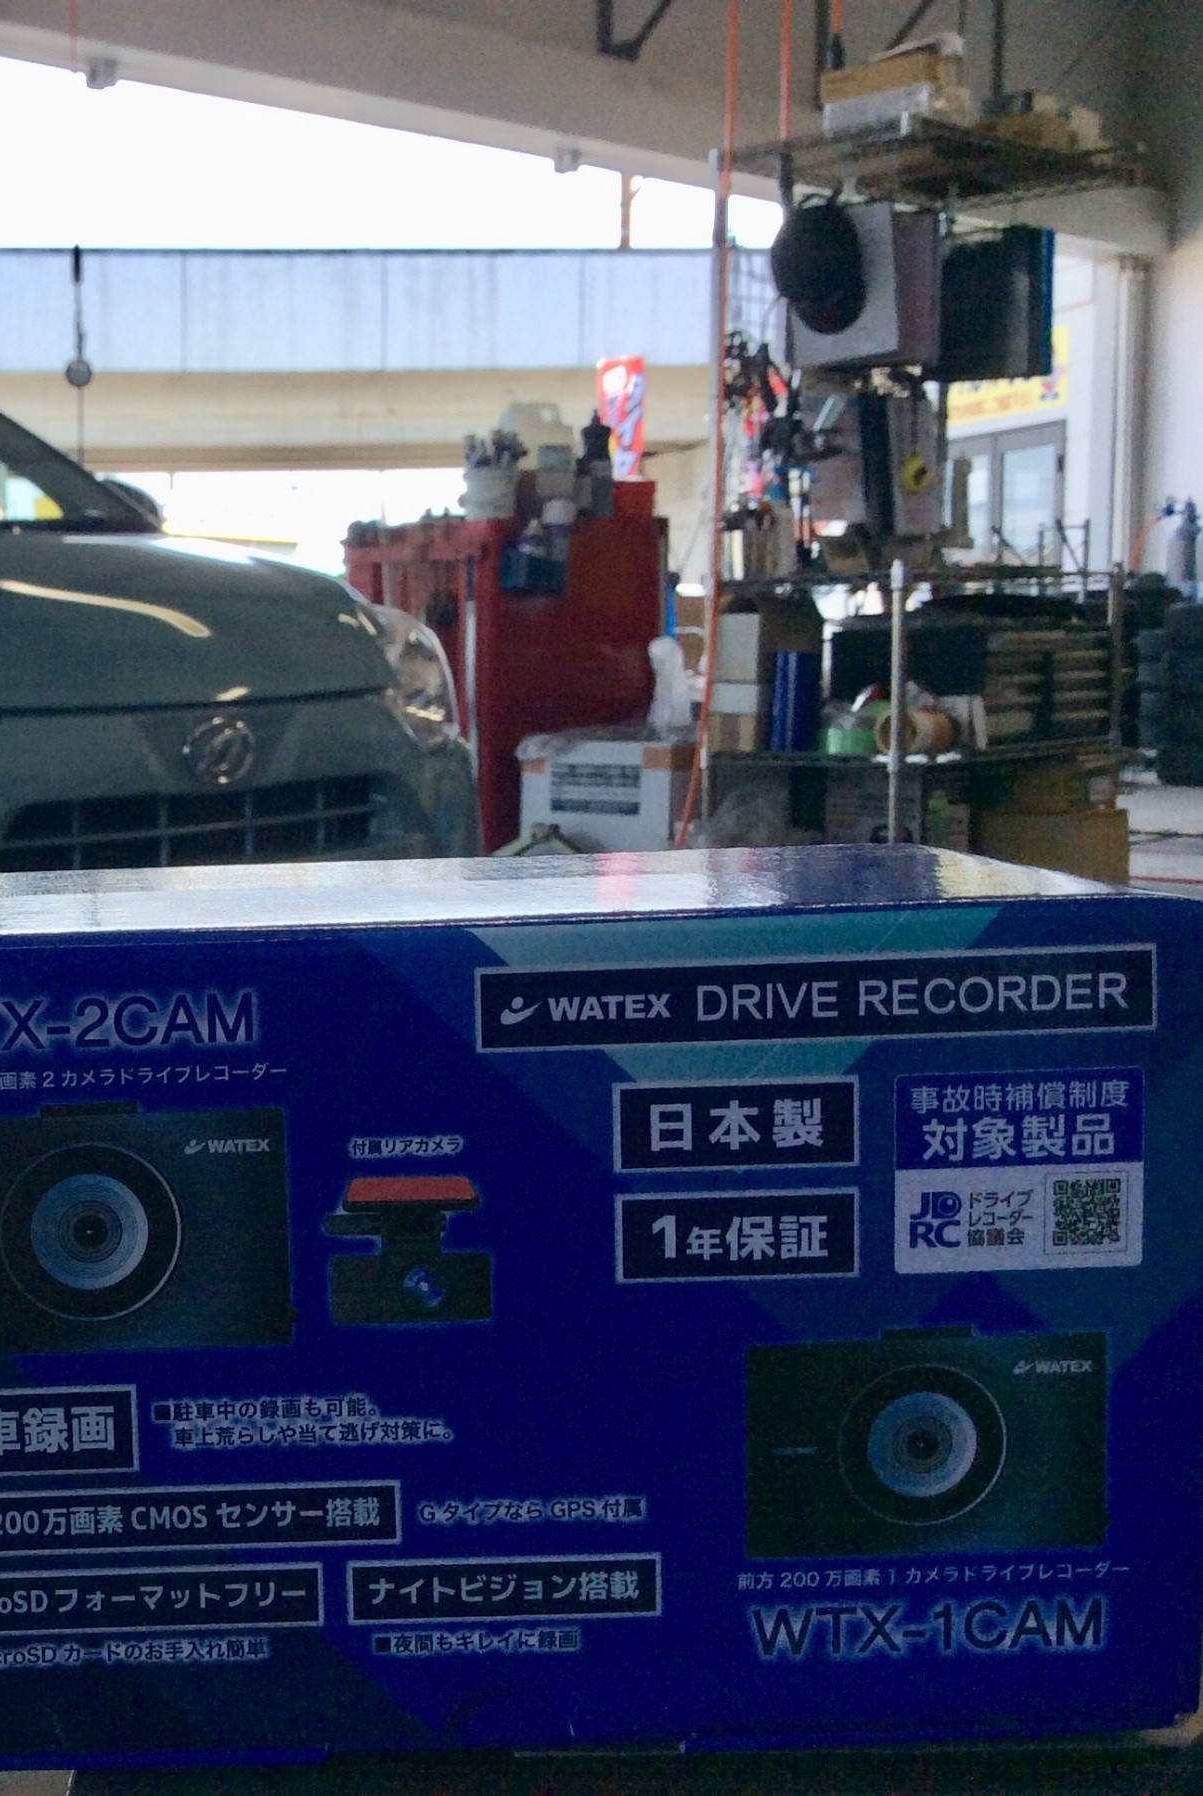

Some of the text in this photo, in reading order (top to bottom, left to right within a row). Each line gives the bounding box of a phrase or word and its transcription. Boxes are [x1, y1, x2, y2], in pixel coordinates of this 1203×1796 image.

[548, 971, 1129, 1022] WATEX DRIVE RECORDER
[910, 1079, 1130, 1115] 事故時補償制度
[649, 1098, 824, 1152] 日本製
[922, 1113, 1116, 1163] 対象製品
[207, 1138, 271, 1154] WATEX
[351, 1135, 461, 1158] 付属リアカメラ
[968, 1189, 1034, 1210] ドライブ
[651, 1213, 829, 1261] 1年保証
[909, 1219, 961, 1249] RC
[1035, 1360, 1092, 1375] WATEX
[368, 1571, 639, 1605] ナイトビジョン搭載
[393, 1630, 579, 1654] 夜間もキレイに録画
[751, 1598, 1102, 1656] WTX-1CAM
